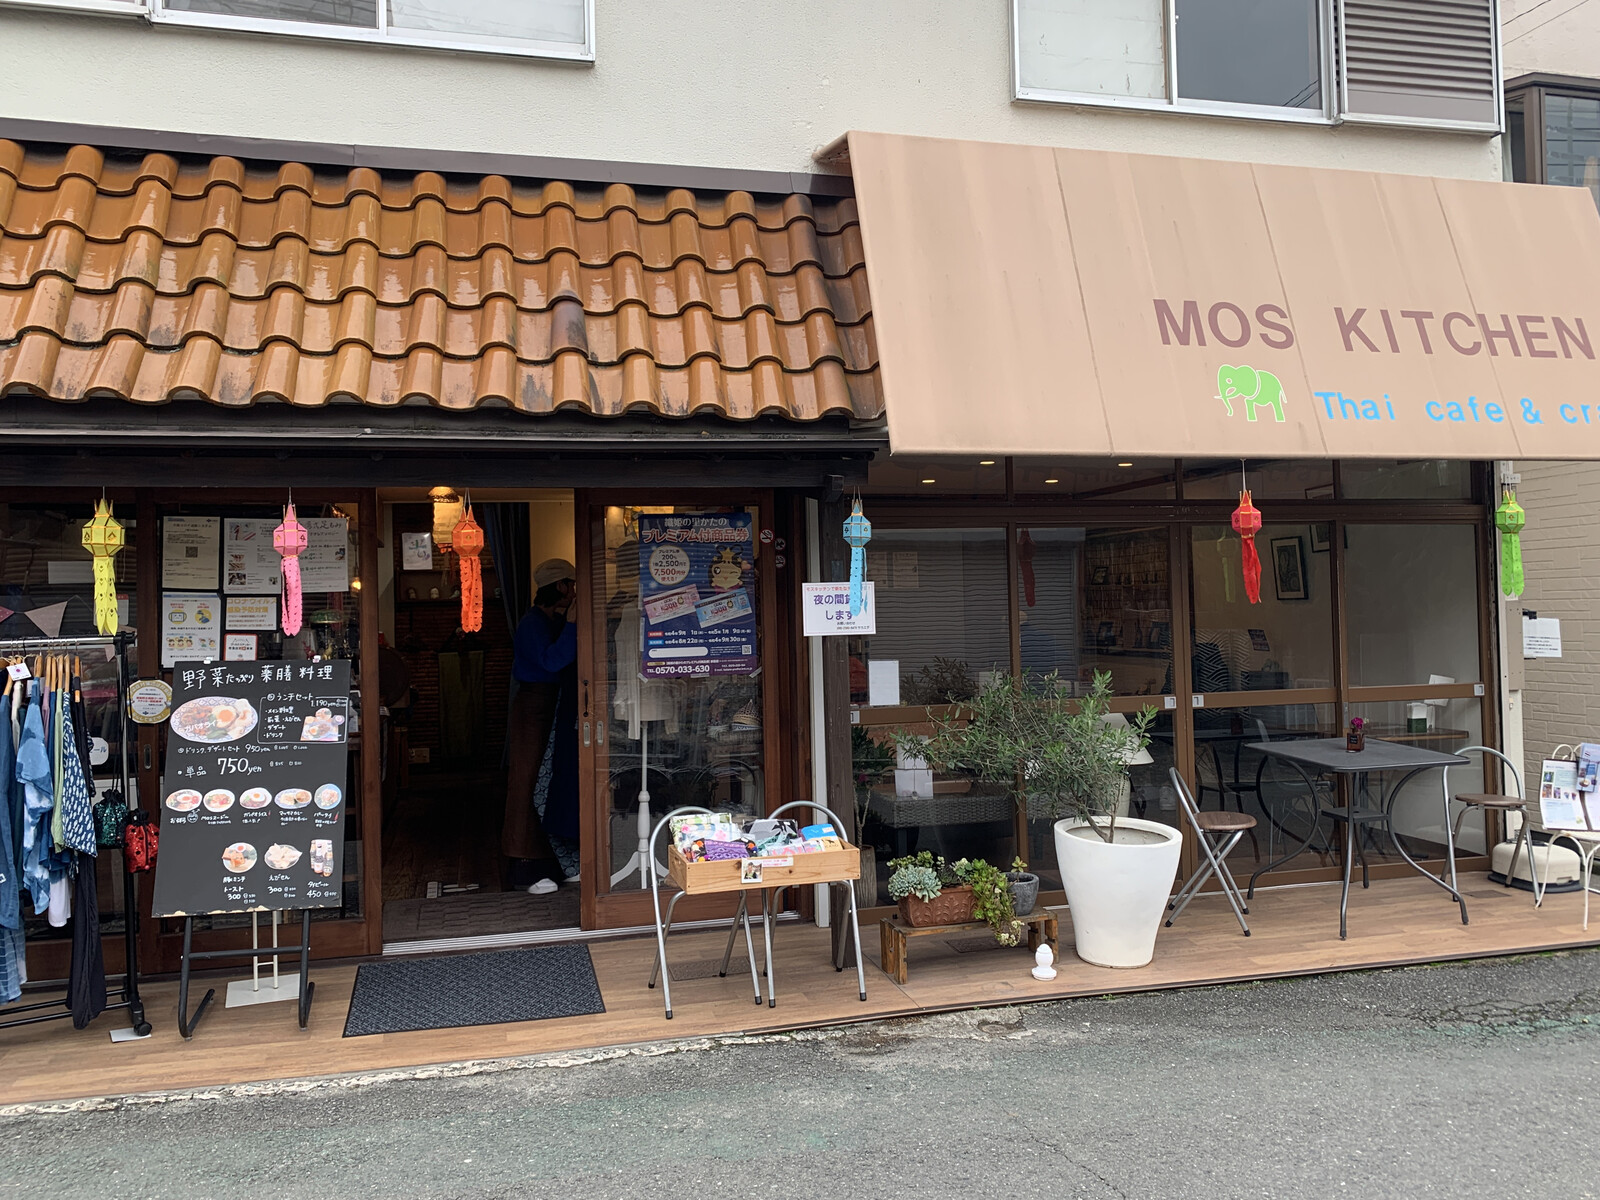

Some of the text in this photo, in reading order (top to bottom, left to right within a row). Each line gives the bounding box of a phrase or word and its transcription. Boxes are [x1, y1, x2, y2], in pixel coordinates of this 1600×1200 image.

[1153, 299, 1596, 360] MOS KITCHEN
[1314, 391, 1600, 425] Thai cafe & cr
[641, 527, 750, 544] プレミアム付商品券
[655, 664, 710, 675] 0570-033-630
[182, 666, 255, 690] 野菜たっぷり
[299, 665, 333, 681] 料理
[185, 765, 207, 778] 単品
[267, 886, 282, 894] 300
[306, 890, 321, 898] 450
